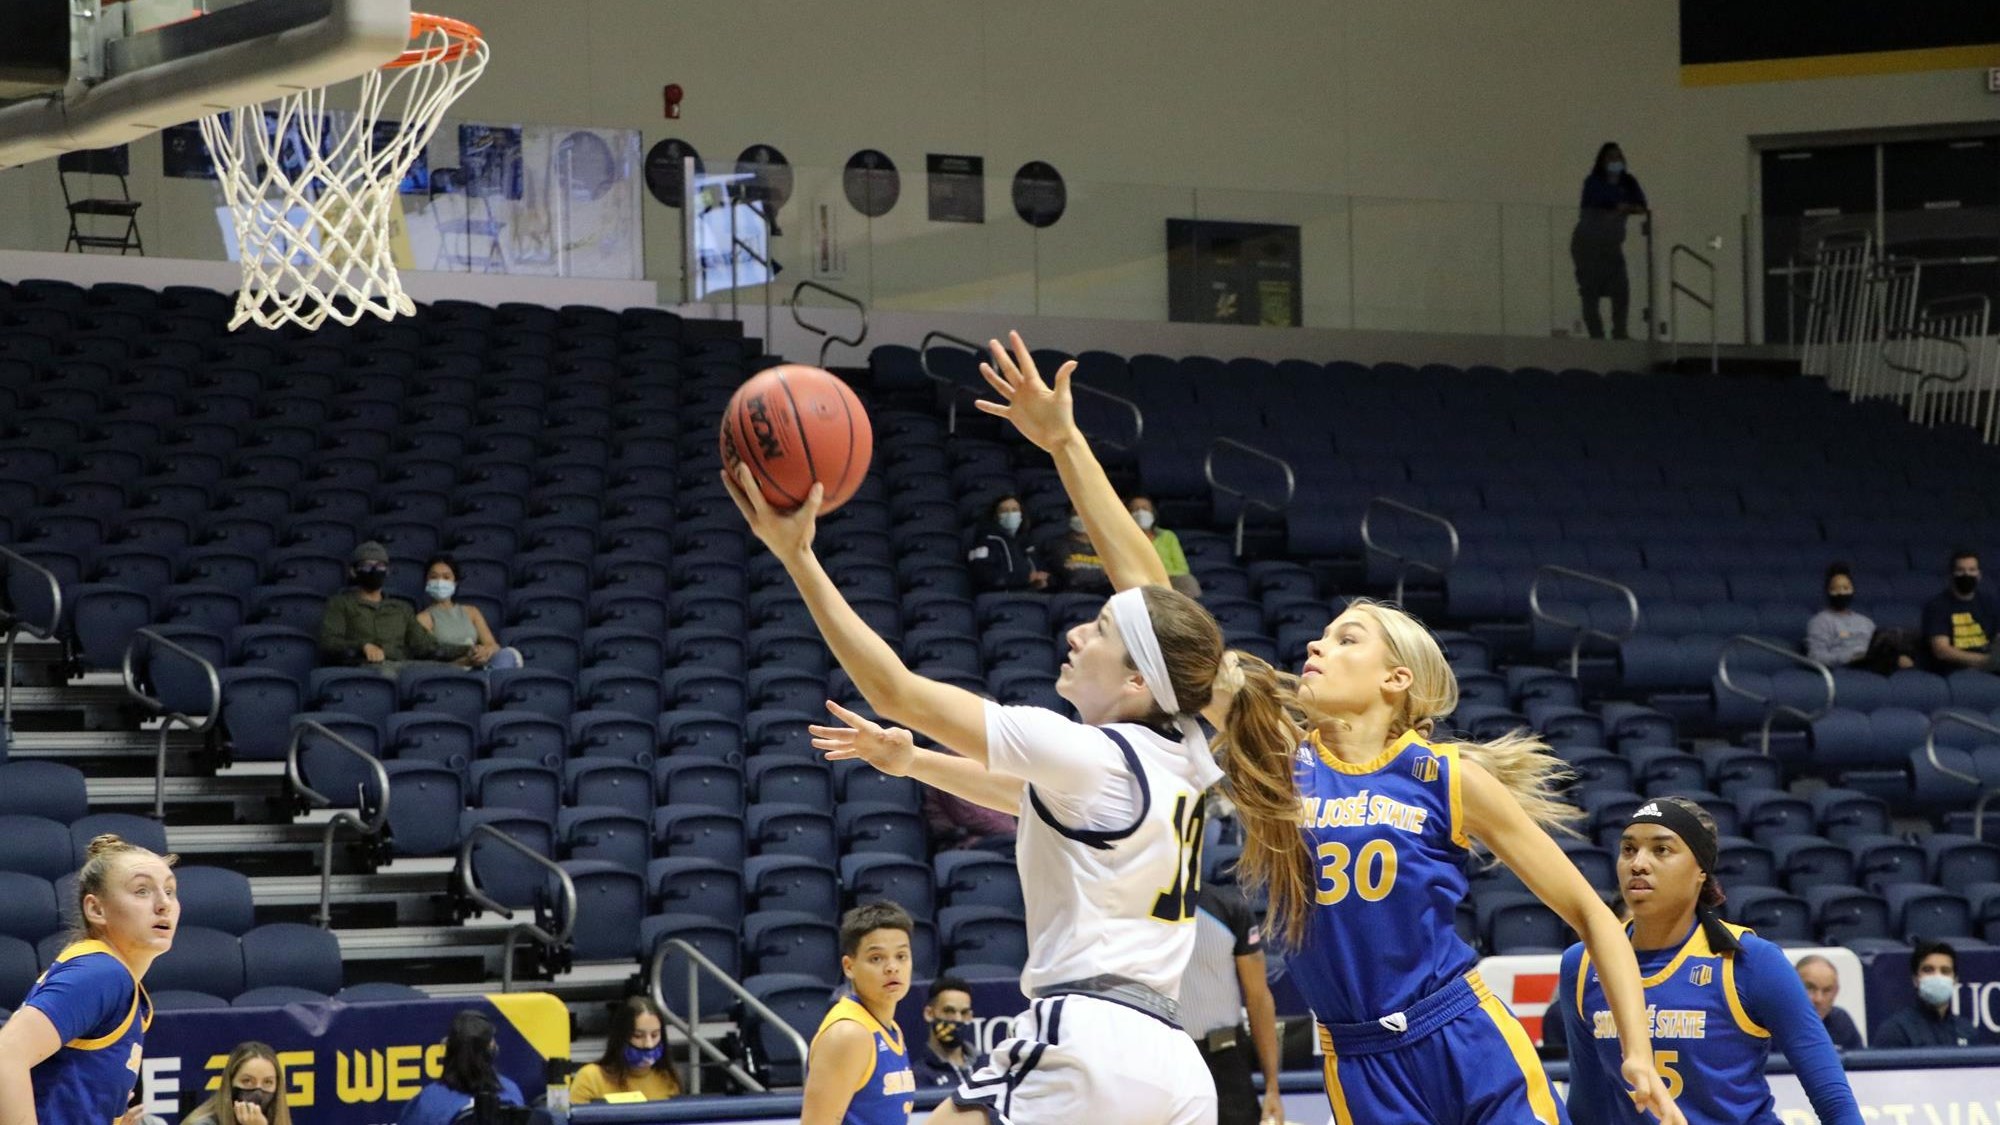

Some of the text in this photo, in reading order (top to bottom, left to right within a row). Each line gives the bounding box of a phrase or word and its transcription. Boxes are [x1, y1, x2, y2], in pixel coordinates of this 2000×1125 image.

[1317, 789, 1370, 829] JOSÉ
[1367, 794, 1428, 835] STATE
[1315, 838, 1398, 906] 30
[1655, 1009, 1707, 1039] STATE
[336, 1043, 447, 1104] WES
